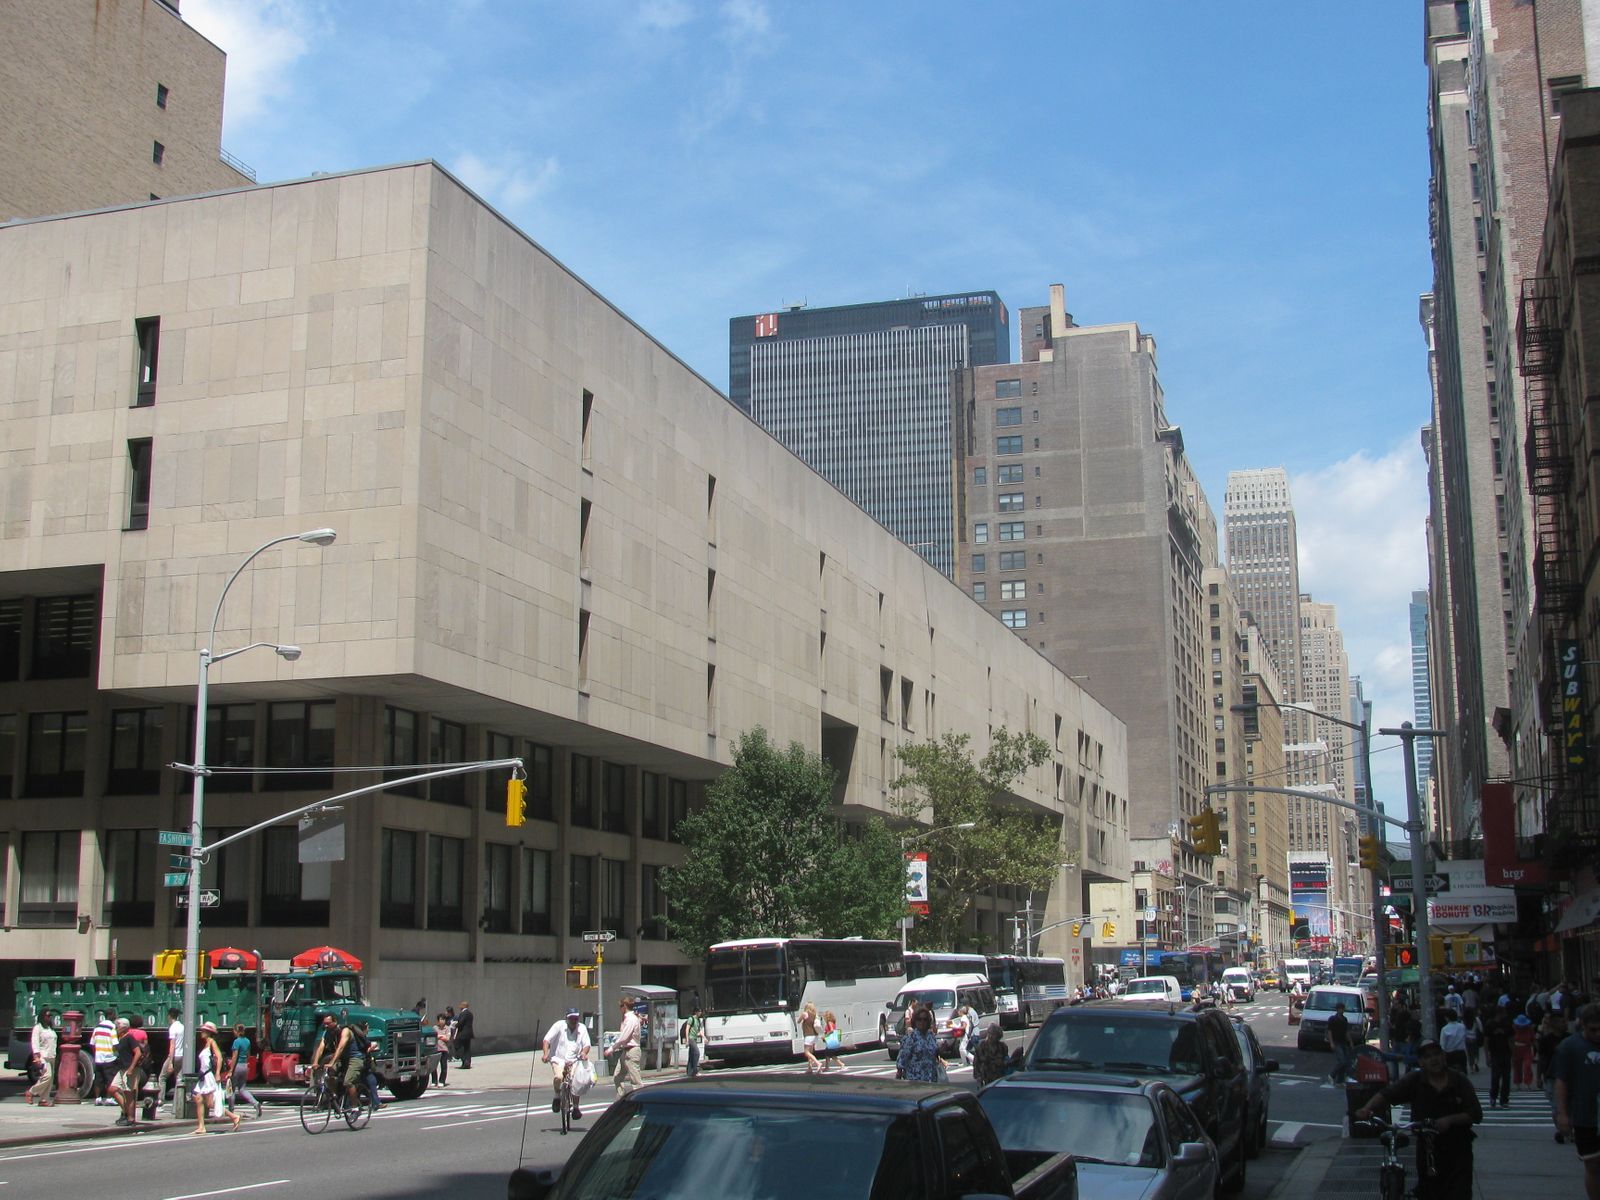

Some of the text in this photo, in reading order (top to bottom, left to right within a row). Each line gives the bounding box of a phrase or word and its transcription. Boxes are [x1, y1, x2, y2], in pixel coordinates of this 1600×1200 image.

[1562, 646, 1584, 747] SUBWAY
[160, 832, 186, 843] FASHION
[202, 894, 214, 902] WAY
[1473, 904, 1491, 917] BR
